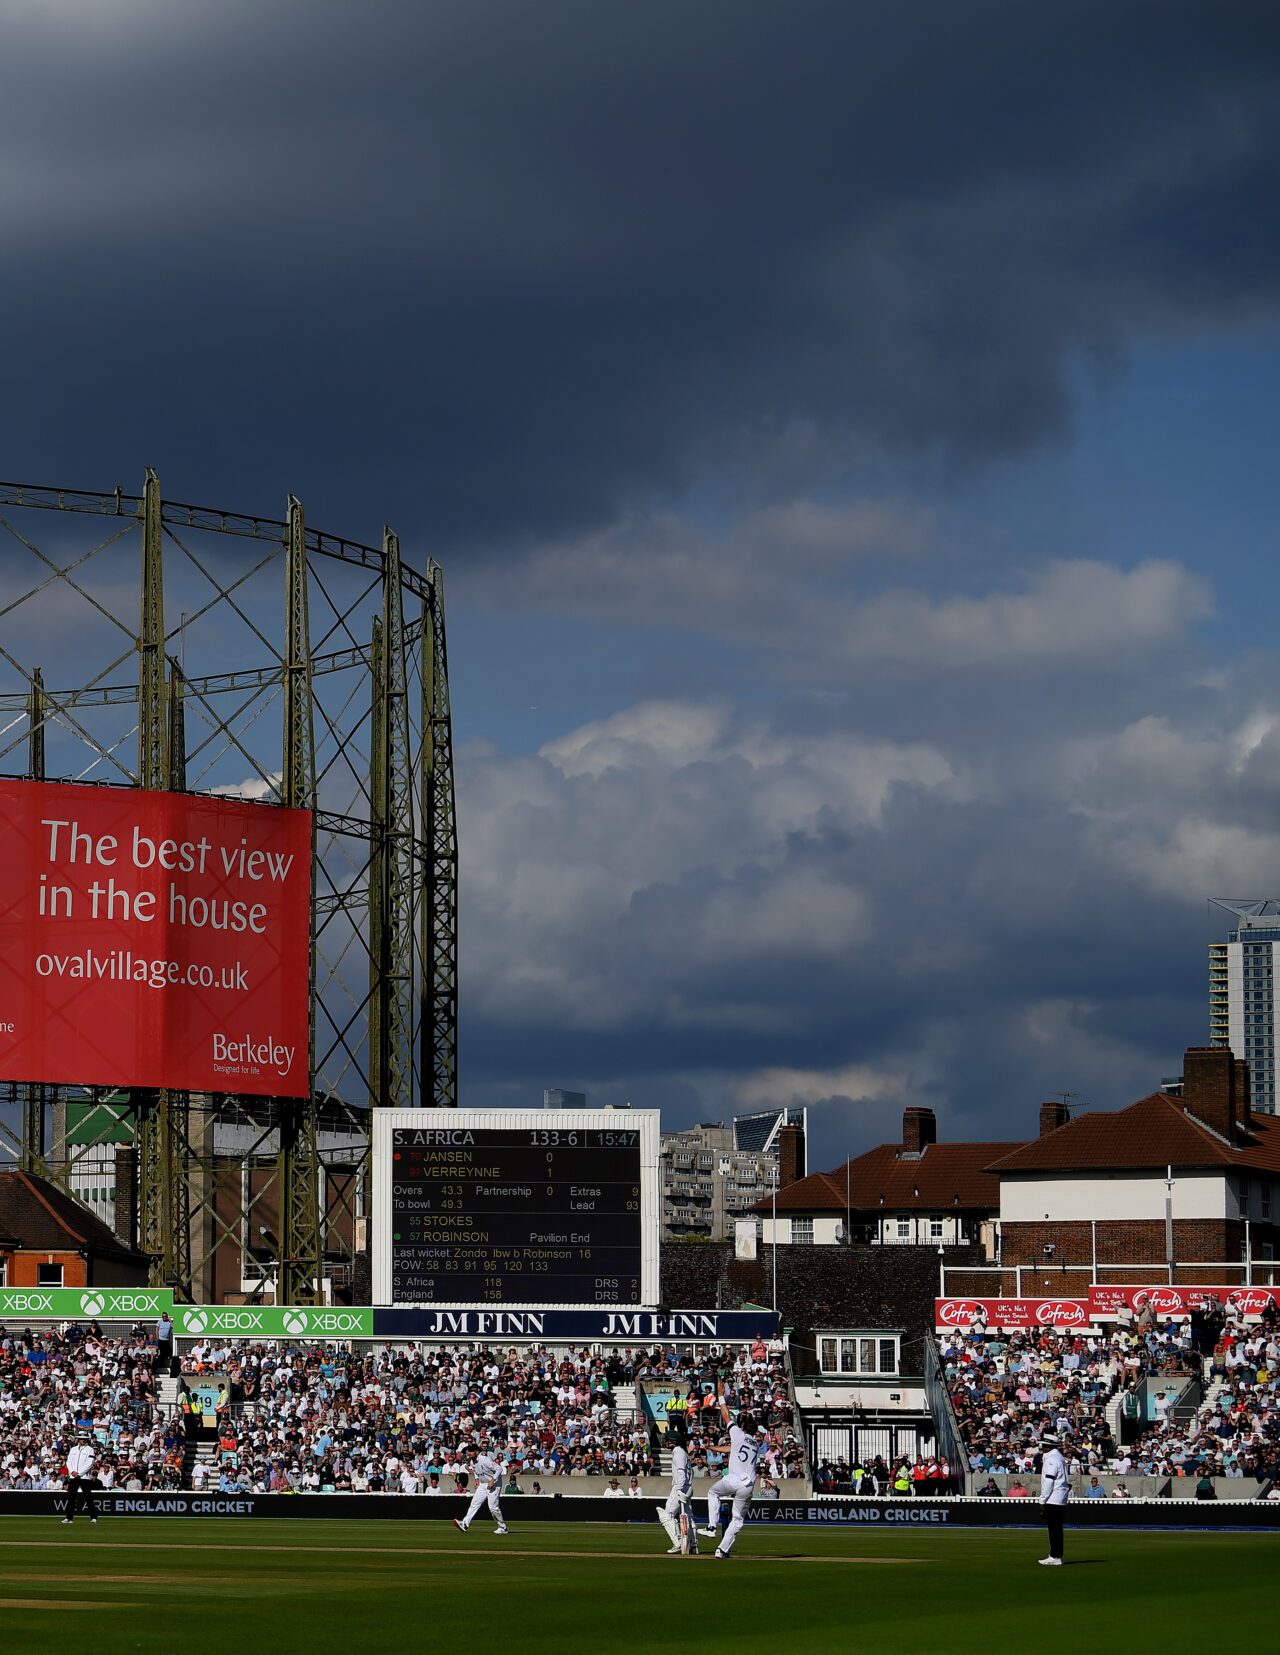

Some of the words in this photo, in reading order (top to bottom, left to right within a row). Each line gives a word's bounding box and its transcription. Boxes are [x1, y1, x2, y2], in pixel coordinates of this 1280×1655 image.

[41, 819, 118, 866] The
[132, 826, 211, 874] best
[221, 838, 294, 882] view
[39, 874, 73, 917] in
[87, 878, 156, 922] the
[169, 882, 267, 933] house
[35, 949, 249, 990] ovalvillage.co.uk
[213, 1033, 295, 1076] Berkeley
[213, 1063, 240, 1074] Designed
[241, 1065, 250, 1074] for
[250, 1066, 260, 1075] life
[394, 1130, 408, 1145] S.
[413, 1130, 475, 1145] AFRICA
[530, 1131, 578, 1146] 133-6
[597, 1132, 637, 1146] 15:47
[423, 1151, 472, 1162] JANSEN
[546, 1152, 553, 1163] 0
[423, 1167, 501, 1177] VERREYNNE
[547, 1168, 552, 1178] 1
[393, 1186, 423, 1195] Overs
[441, 1186, 463, 1195] 43.3
[476, 1185, 532, 1198] Partnership
[546, 1186, 553, 1196] 0
[570, 1186, 601, 1196] Extras
[632, 1187, 639, 1196] 9
[393, 1200, 405, 1209] To
[407, 1200, 431, 1209] bowl
[441, 1200, 463, 1209] 49.3
[570, 1200, 595, 1210] Lead
[626, 1201, 639, 1210] 93
[409, 1217, 421, 1226] 55
[423, 1216, 473, 1226] STOKES
[409, 1232, 421, 1241] 57
[423, 1232, 489, 1242] ROBINSON
[530, 1233, 568, 1244] Pavilion
[570, 1233, 590, 1244] End
[393, 1248, 416, 1257] Last
[454, 1248, 488, 1258] Zondo
[523, 1249, 572, 1259] Robinson
[579, 1250, 591, 1259] 16
[426, 1260, 439, 1270] 58
[445, 1260, 459, 1270] 83
[464, 1260, 477, 1270] 91
[484, 1260, 497, 1270] 95
[504, 1261, 523, 1271] 120
[529, 1261, 549, 1271] 133
[393, 1277, 404, 1286] S.
[406, 1277, 435, 1286] Africa
[484, 1278, 502, 1287] 118
[595, 1278, 619, 1288] DRS
[631, 1279, 638, 1288] 2
[2, 1294, 53, 1311] XBOX
[108, 1295, 160, 1312] XBOX
[393, 1290, 433, 1300] England
[484, 1290, 502, 1299] 158
[595, 1291, 619, 1301] DRS
[631, 1291, 638, 1301] 0
[1134, 1291, 1180, 1309] Cfresh
[211, 1312, 263, 1329] XBOX
[941, 1302, 984, 1323] Cofre
[1037, 1303, 1084, 1325] Cofresh
[311, 1313, 363, 1330] XBOX
[429, 1312, 470, 1333] JM
[475, 1313, 546, 1334] FINN
[602, 1313, 642, 1335] JM
[649, 1314, 719, 1336] FINN
[199, 1396, 212, 1408] 19
[737, 1444, 758, 1466] 57
[53, 1499, 77, 1511] W
[115, 1500, 187, 1513] ENGLAND
[191, 1501, 255, 1513] CRICKET
[747, 1507, 769, 1520] WE
[774, 1507, 804, 1520] ARE
[807, 1508, 881, 1521] ENGLAND
[885, 1509, 949, 1522] CRICKET
